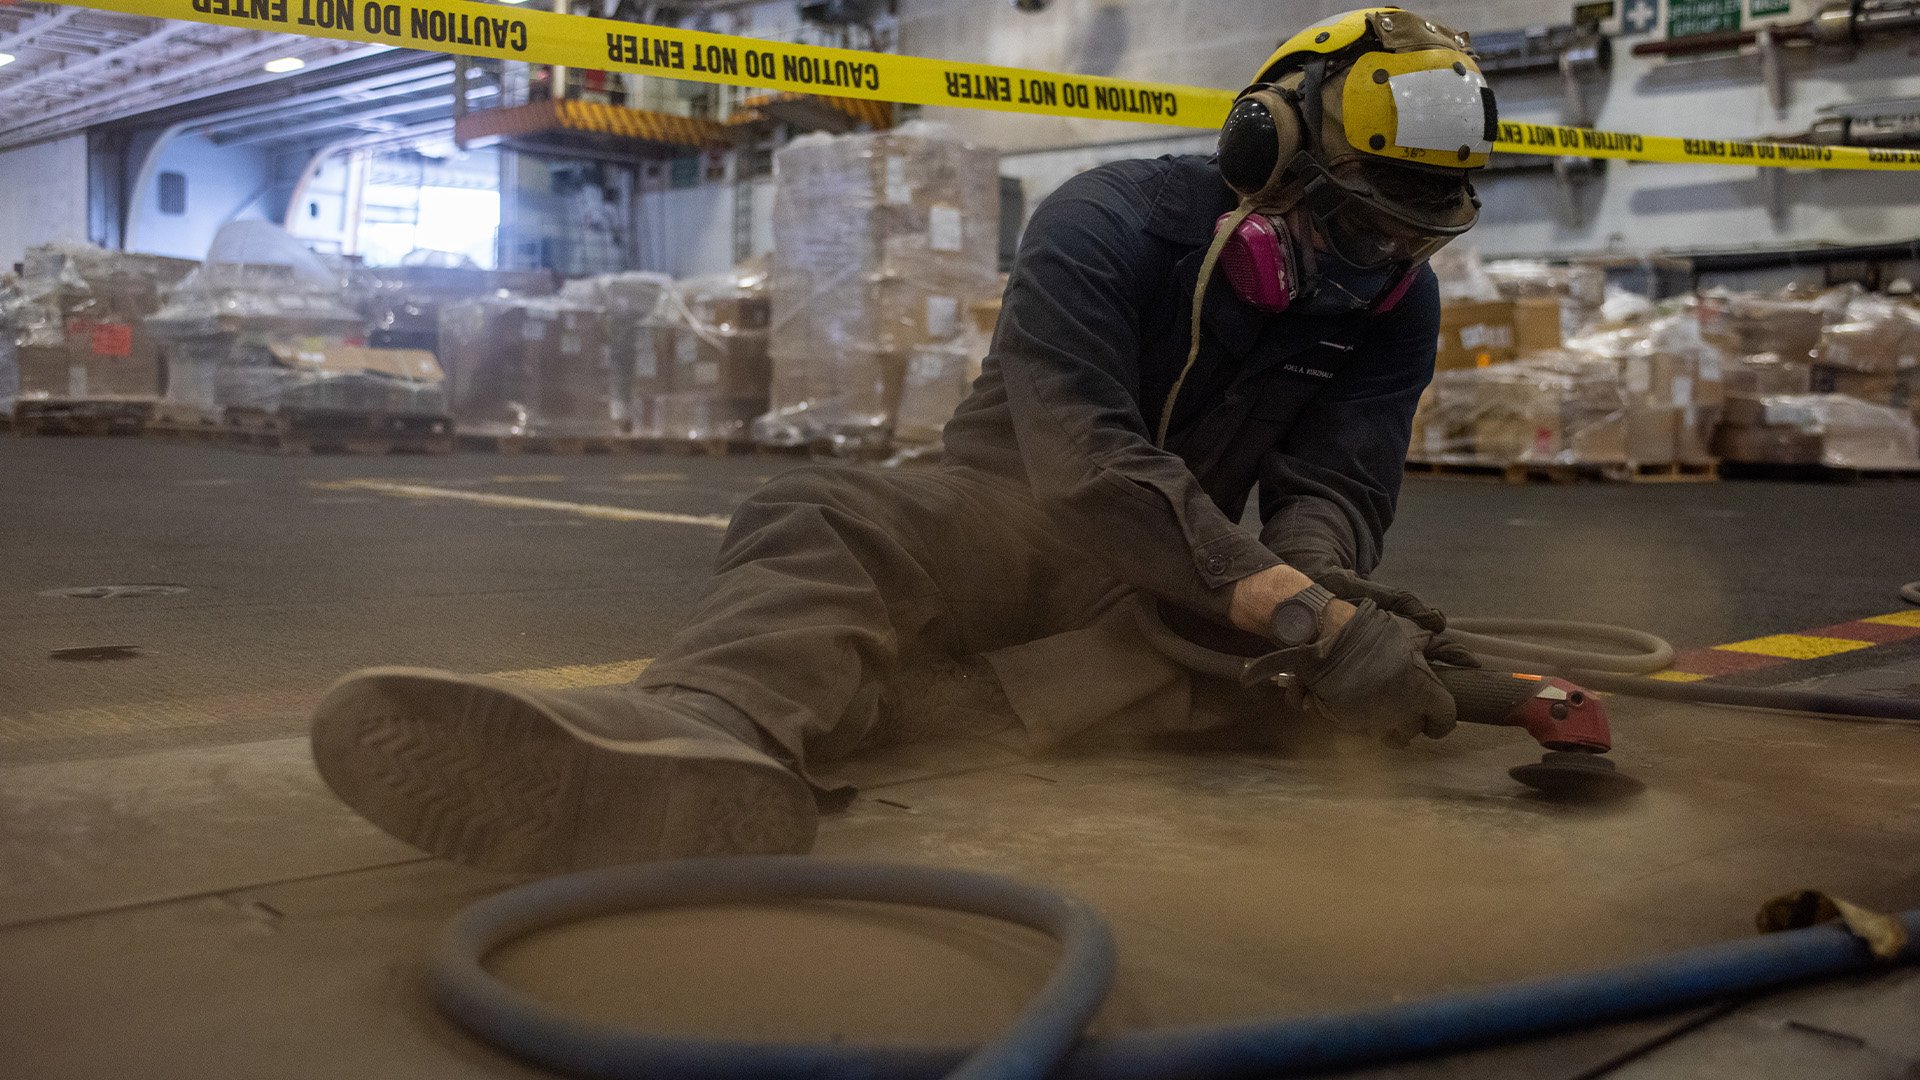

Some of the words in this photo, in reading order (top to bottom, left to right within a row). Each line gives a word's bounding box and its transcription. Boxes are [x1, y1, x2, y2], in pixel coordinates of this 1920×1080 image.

[298, 0, 354, 31] NOT
[363, 1, 401, 37] DO
[411, 8, 528, 51] CAUTION
[606, 32, 685, 69] ENTER
[693, 44, 738, 76] NOT
[745, 49, 776, 79] DO
[783, 54, 879, 91] CAUTION
[944, 71, 1012, 102] ENTER
[1018, 79, 1058, 107] NOT
[1062, 83, 1090, 109] DO
[1094, 86, 1178, 117] CAUTION
[1497, 122, 1523, 144] ENT
[1526, 124, 1556, 146] NOT
[1558, 127, 1580, 148] DO
[1582, 129, 1643, 152] CAUTION
[1682, 139, 1725, 157] ENTER
[1729, 142, 1754, 158] NOT
